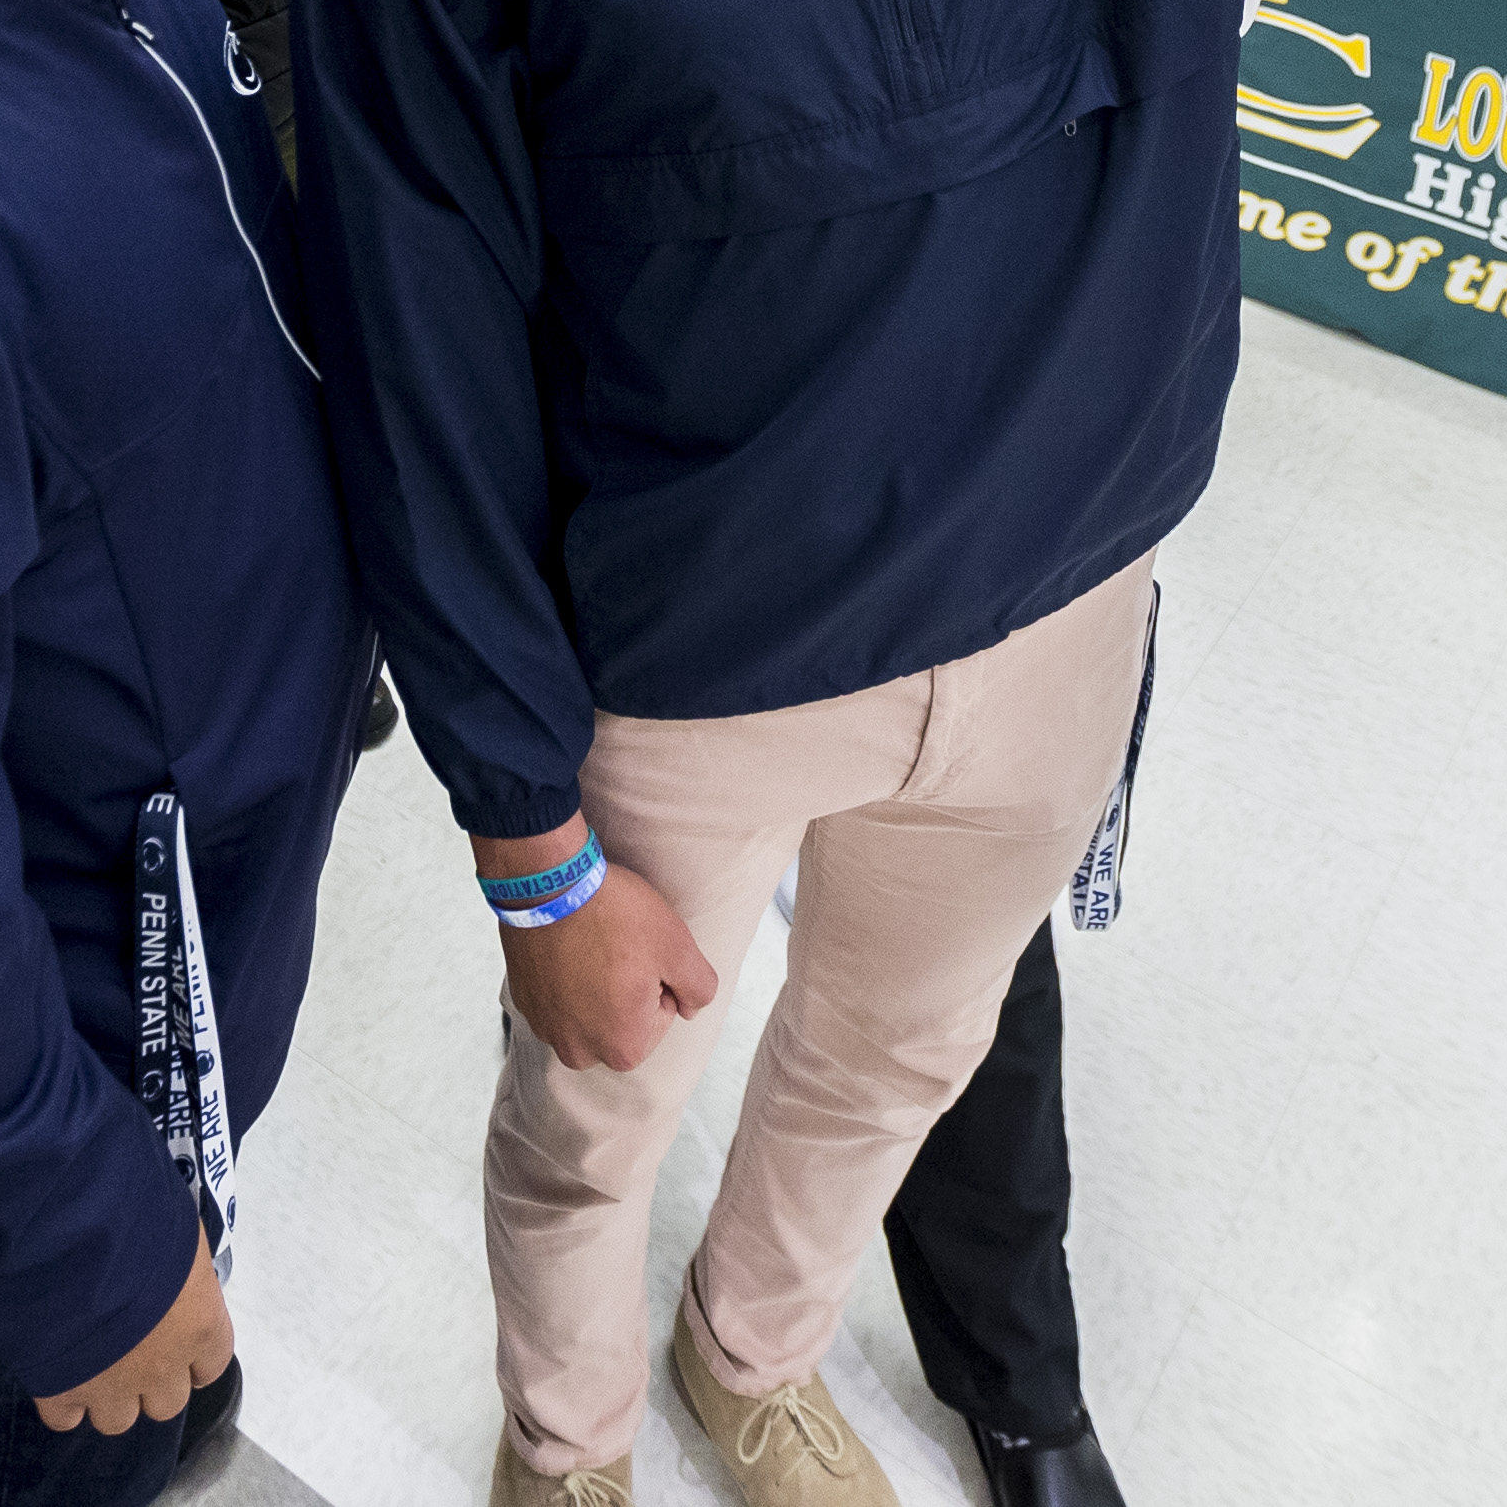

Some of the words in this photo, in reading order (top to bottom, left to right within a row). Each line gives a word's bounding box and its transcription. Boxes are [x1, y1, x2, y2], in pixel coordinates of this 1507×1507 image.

[1239, 190, 1332, 251] me
[1345, 230, 1443, 292] of
[1094, 843, 1114, 884] WE
[142, 893, 166, 967] PENN
[1086, 890, 1110, 930] ARE
[142, 976, 166, 1056] STATE
[202, 1090, 222, 1141] ARE
[205, 1140, 228, 1192] WE
